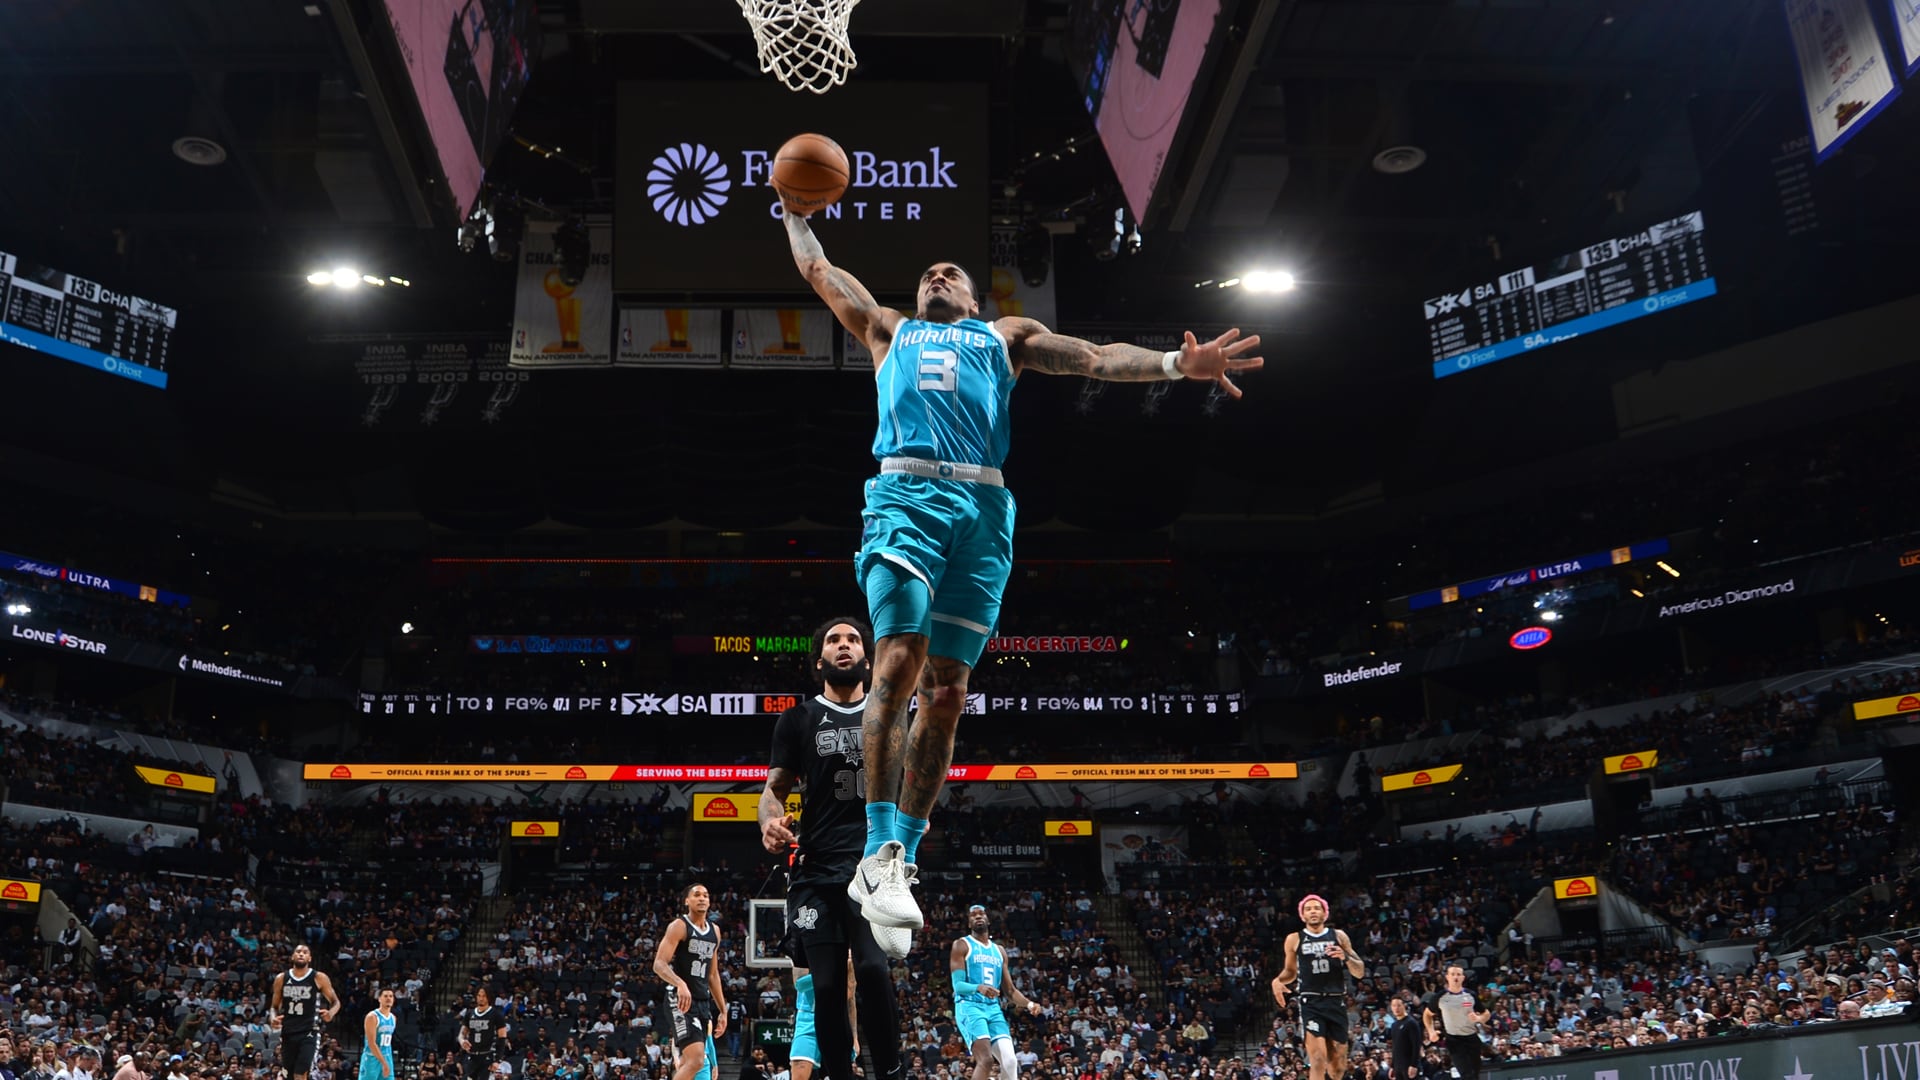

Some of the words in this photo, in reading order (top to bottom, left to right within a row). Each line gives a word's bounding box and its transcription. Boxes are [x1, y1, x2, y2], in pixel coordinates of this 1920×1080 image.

[852, 146, 958, 188] Bank
[769, 202, 922, 220] CNTER
[1586, 243, 1613, 264] 135
[1618, 232, 1651, 253] CHA
[526, 252, 610, 265] CHANS
[70, 278, 96, 300] 135
[100, 290, 130, 309] CHA
[1474, 283, 1496, 300] SA
[1507, 272, 1526, 290] 111
[1660, 291, 1688, 307] Frost
[898, 328, 987, 349] HORNETS
[643, 352, 684, 360] ANTONIO
[1472, 350, 1496, 365] Frost
[118, 362, 143, 378] Frost
[417, 372, 469, 383] 2003
[478, 371, 530, 382] 2005
[919, 350, 959, 392] 3
[361, 374, 408, 384] 1999
[1538, 561, 1582, 579] ULTRA
[69, 571, 111, 590] ULTRA
[1659, 597, 1724, 618] Americus
[1725, 579, 1795, 604] Diamond
[12, 624, 56, 645] LONE
[66, 635, 107, 654] STAR
[525, 635, 609, 653] GLORIA
[713, 636, 751, 653] TACOS
[756, 636, 813, 653] MARGARI
[192, 659, 242, 679] Methodist
[1323, 661, 1402, 687] Bitdefender
[430, 703, 436, 714] 4
[456, 697, 480, 710] TO
[486, 697, 493, 711] 3
[505, 697, 548, 710] FG%
[552, 698, 570, 711] 47.1
[578, 698, 602, 710] PF
[610, 698, 617, 711] 2
[681, 695, 708, 713] SA
[719, 696, 744, 713] 111
[763, 696, 796, 713] 6:50
[992, 698, 1015, 710] PF
[1020, 697, 1027, 711] 2
[1037, 697, 1080, 710] FG%
[1109, 697, 1133, 710] TO
[1141, 697, 1148, 711] 3
[1164, 703, 1170, 714] 2
[815, 726, 863, 757] SAT
[505, 769, 531, 777] SPURS
[636, 768, 682, 777] SERVING
[685, 768, 705, 777] THE
[708, 768, 733, 777] BEST
[736, 768, 768, 777] FRESH
[947, 768, 967, 777] 987
[1138, 768, 1156, 776] MEX
[1159, 768, 1169, 776] OF
[1189, 767, 1215, 775] SPURS
[971, 845, 1013, 855] BASELINE
[1016, 845, 1041, 855] BUMS
[1311, 958, 1331, 975] 10
[982, 966, 994, 987] 5
[288, 1001, 304, 1016] 14
[380, 1034, 392, 1047] 10
[1650, 1062, 1695, 1080] LIVE
[1699, 1057, 1743, 1080] OAK
